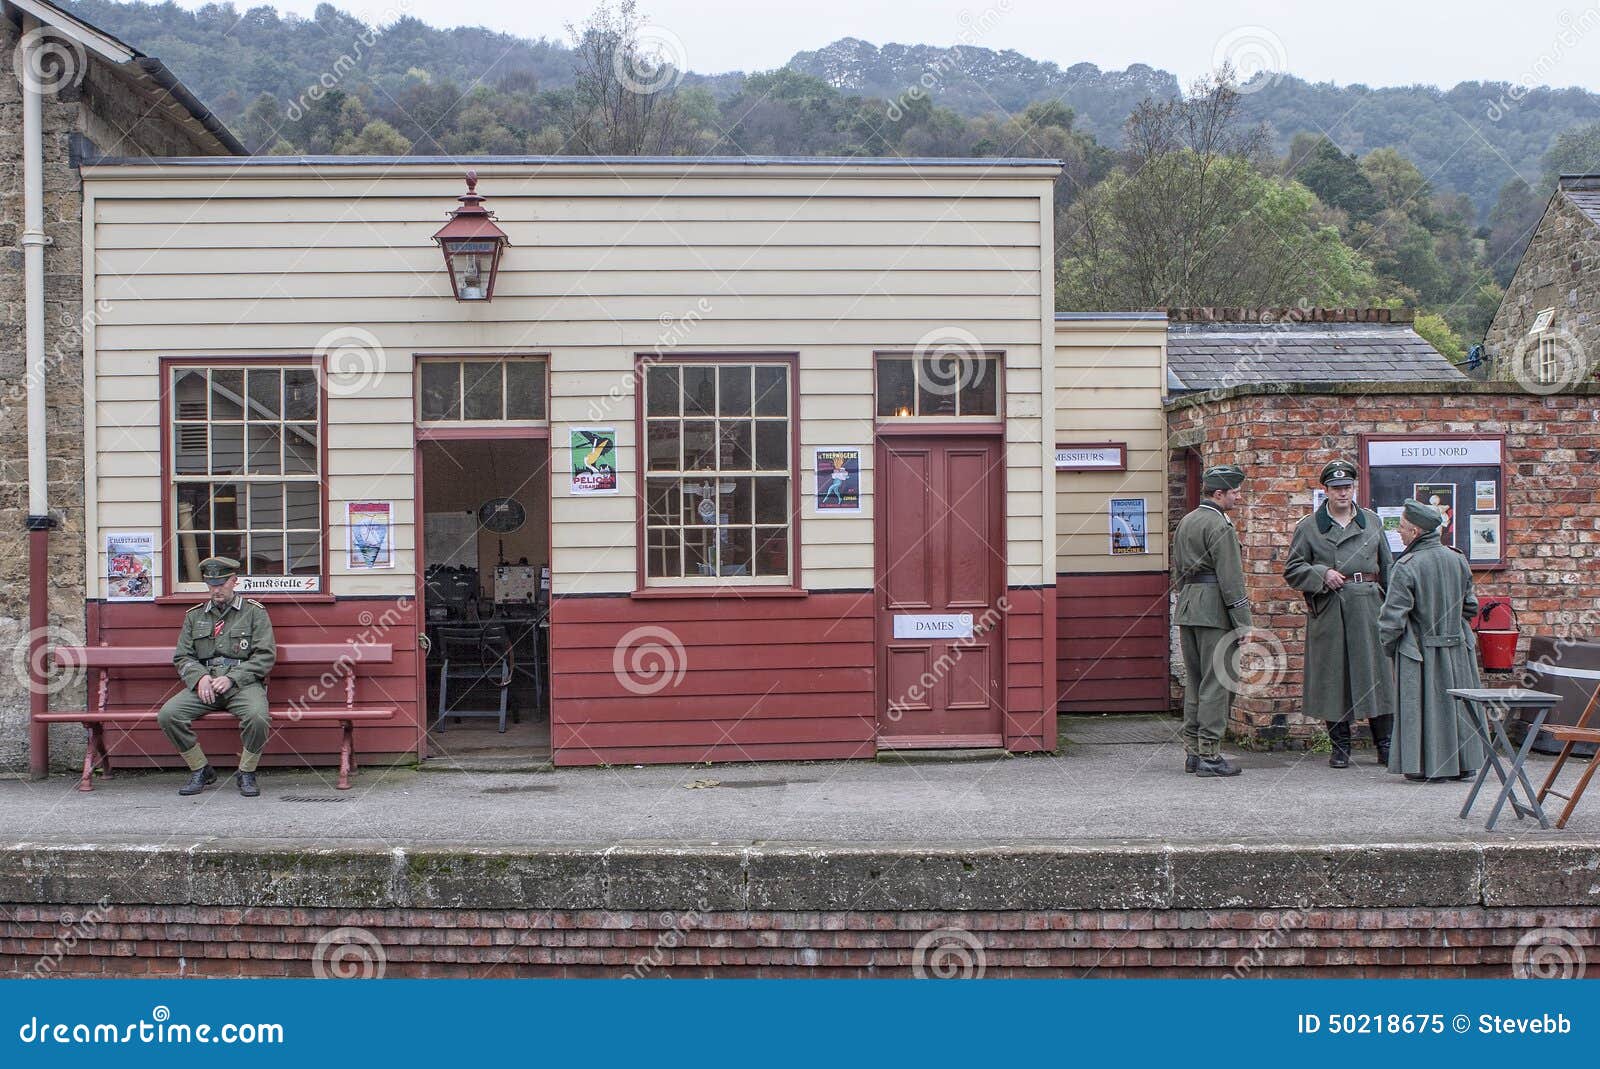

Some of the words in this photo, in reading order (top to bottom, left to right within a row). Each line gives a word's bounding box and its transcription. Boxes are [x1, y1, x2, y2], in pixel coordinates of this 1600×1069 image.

[1401, 447, 1420, 457] EST
[1422, 447, 1437, 457] DU
[1438, 447, 1468, 457] NORD
[915, 621, 955, 631] DAMES
